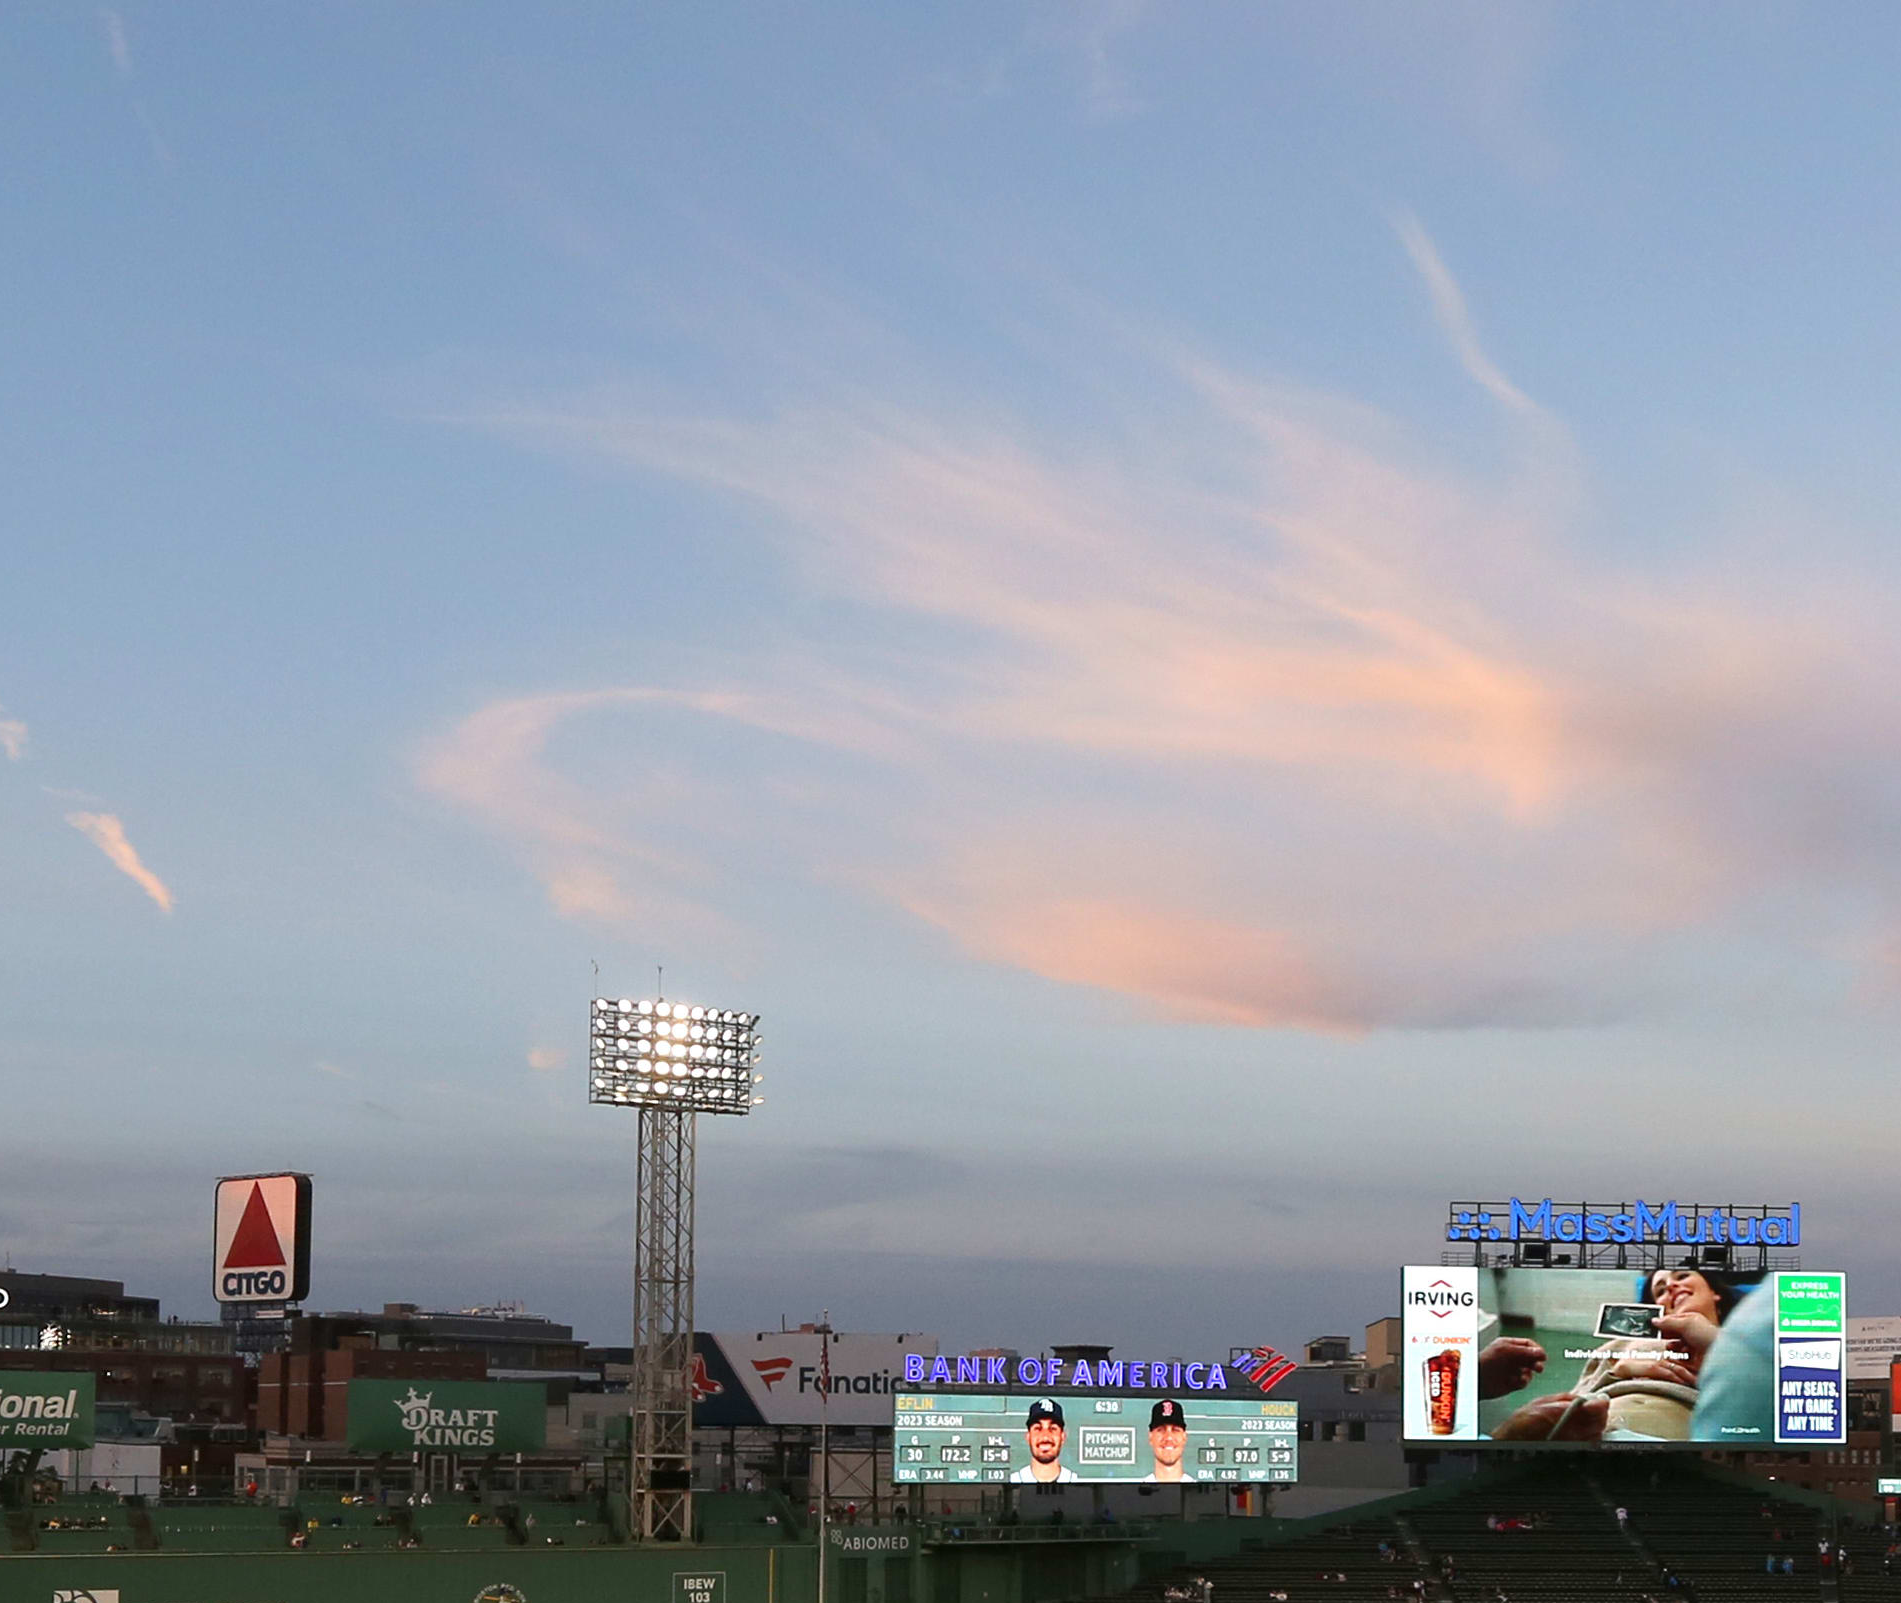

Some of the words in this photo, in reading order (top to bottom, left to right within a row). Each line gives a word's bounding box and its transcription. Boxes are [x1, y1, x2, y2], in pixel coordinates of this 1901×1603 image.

[1509, 1197, 1800, 1245] MassMutual
[222, 1270, 286, 1298] CITGO
[1408, 1291, 1474, 1307] IRVING
[904, 1353, 1007, 1385] BANK
[1018, 1357, 1063, 1387] OF
[1071, 1359, 1228, 1390] AMERICA
[1782, 1381, 1802, 1396] ANY
[897, 1397, 933, 1409] EFLIN
[1096, 1401, 1118, 1413] 6:30
[1783, 1398, 1804, 1414] ANY
[401, 1407, 499, 1430] DRAFT
[897, 1416, 923, 1425] 2023
[925, 1416, 963, 1426] SEASON
[1787, 1416, 1808, 1431] ANY
[1809, 1416, 1834, 1431] TIME
[14, 1422, 70, 1436] Rental
[1241, 1420, 1262, 1430] 2023
[1264, 1420, 1297, 1430] SEASON
[413, 1426, 496, 1446] KINGS
[1085, 1433, 1128, 1445] PITCHING
[907, 1450, 923, 1461] 30
[942, 1450, 970, 1461] 172.2
[983, 1450, 1008, 1461] 15-8
[1084, 1447, 1129, 1458] MATCHUP
[1206, 1451, 1217, 1462] 19
[1234, 1451, 1258, 1462] 97.0
[1273, 1451, 1290, 1462] 5-9
[898, 1470, 918, 1480] ERA
[1198, 1469, 1214, 1480] ERA
[842, 1535, 909, 1552] ABIOMED
[683, 1578, 716, 1590] IBEW
[689, 1591, 711, 1603] 103
